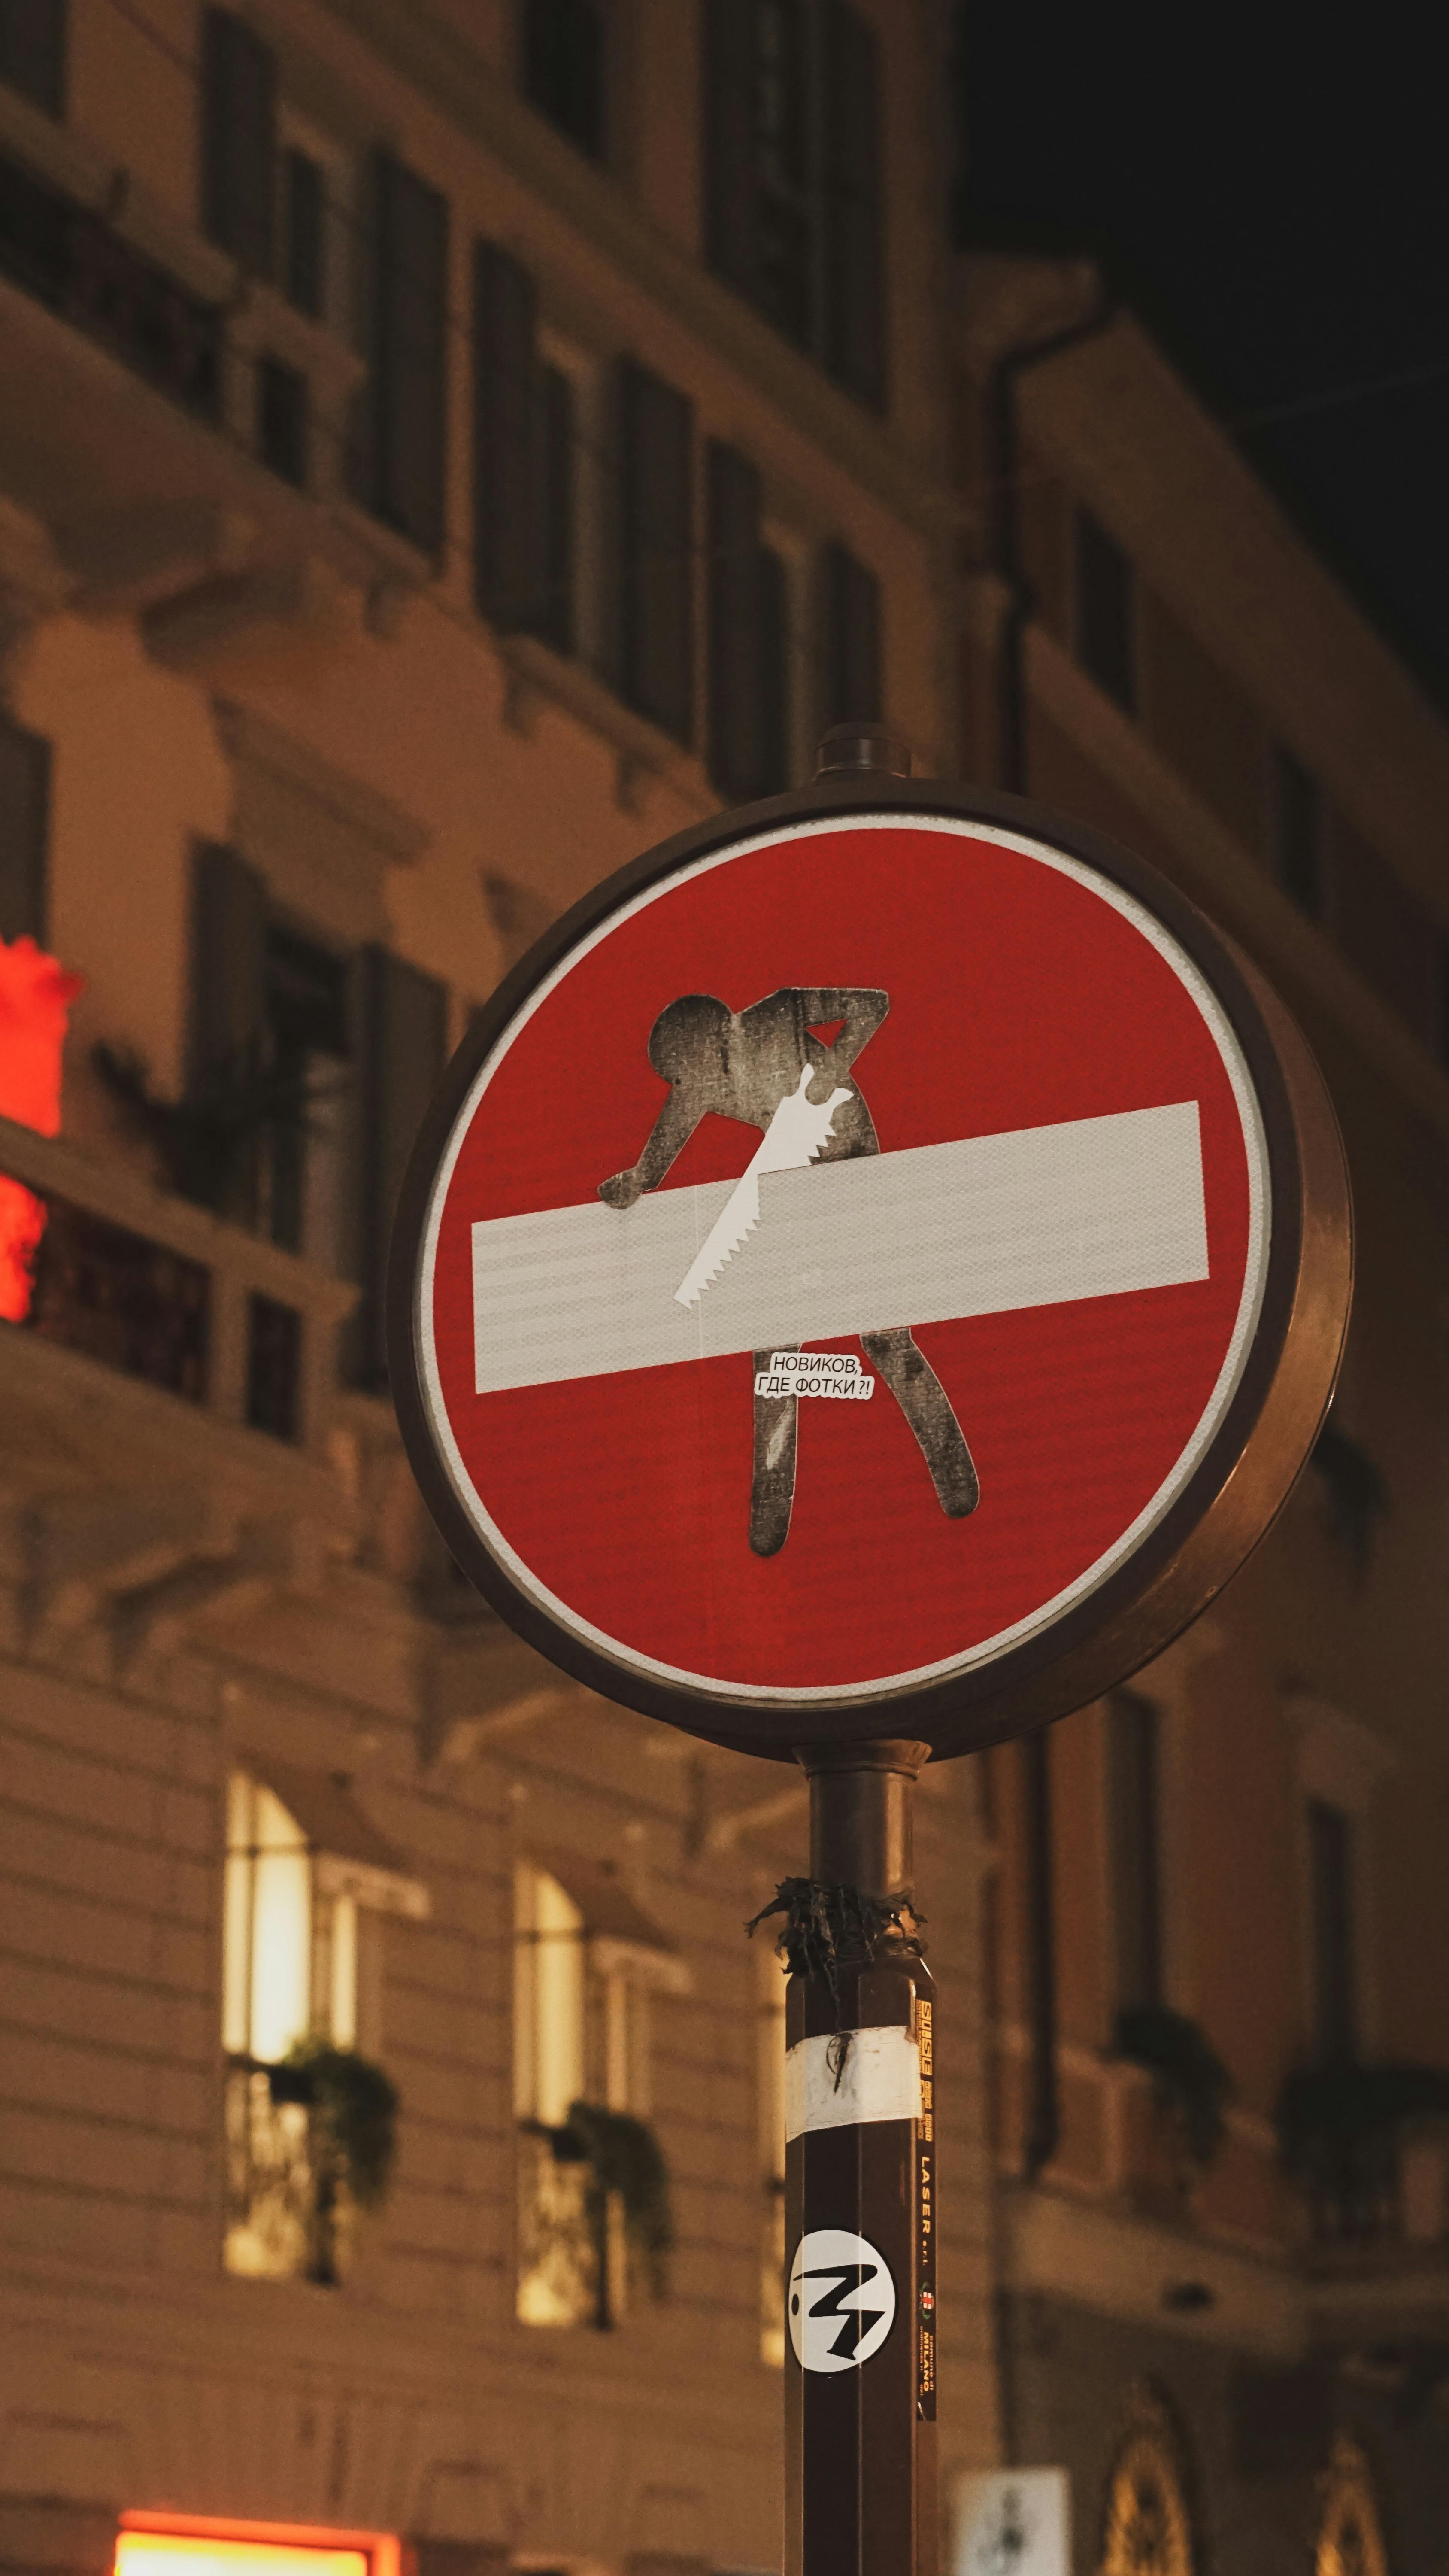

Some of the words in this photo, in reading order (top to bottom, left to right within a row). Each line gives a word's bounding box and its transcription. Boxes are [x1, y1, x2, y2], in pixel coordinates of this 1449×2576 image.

[774, 1356, 858, 1375] НОВИКОВ,
[758, 1376, 790, 1394] ГДЕ
[922, 2156, 930, 2233] LASER
[929, 2381, 934, 2390] di
